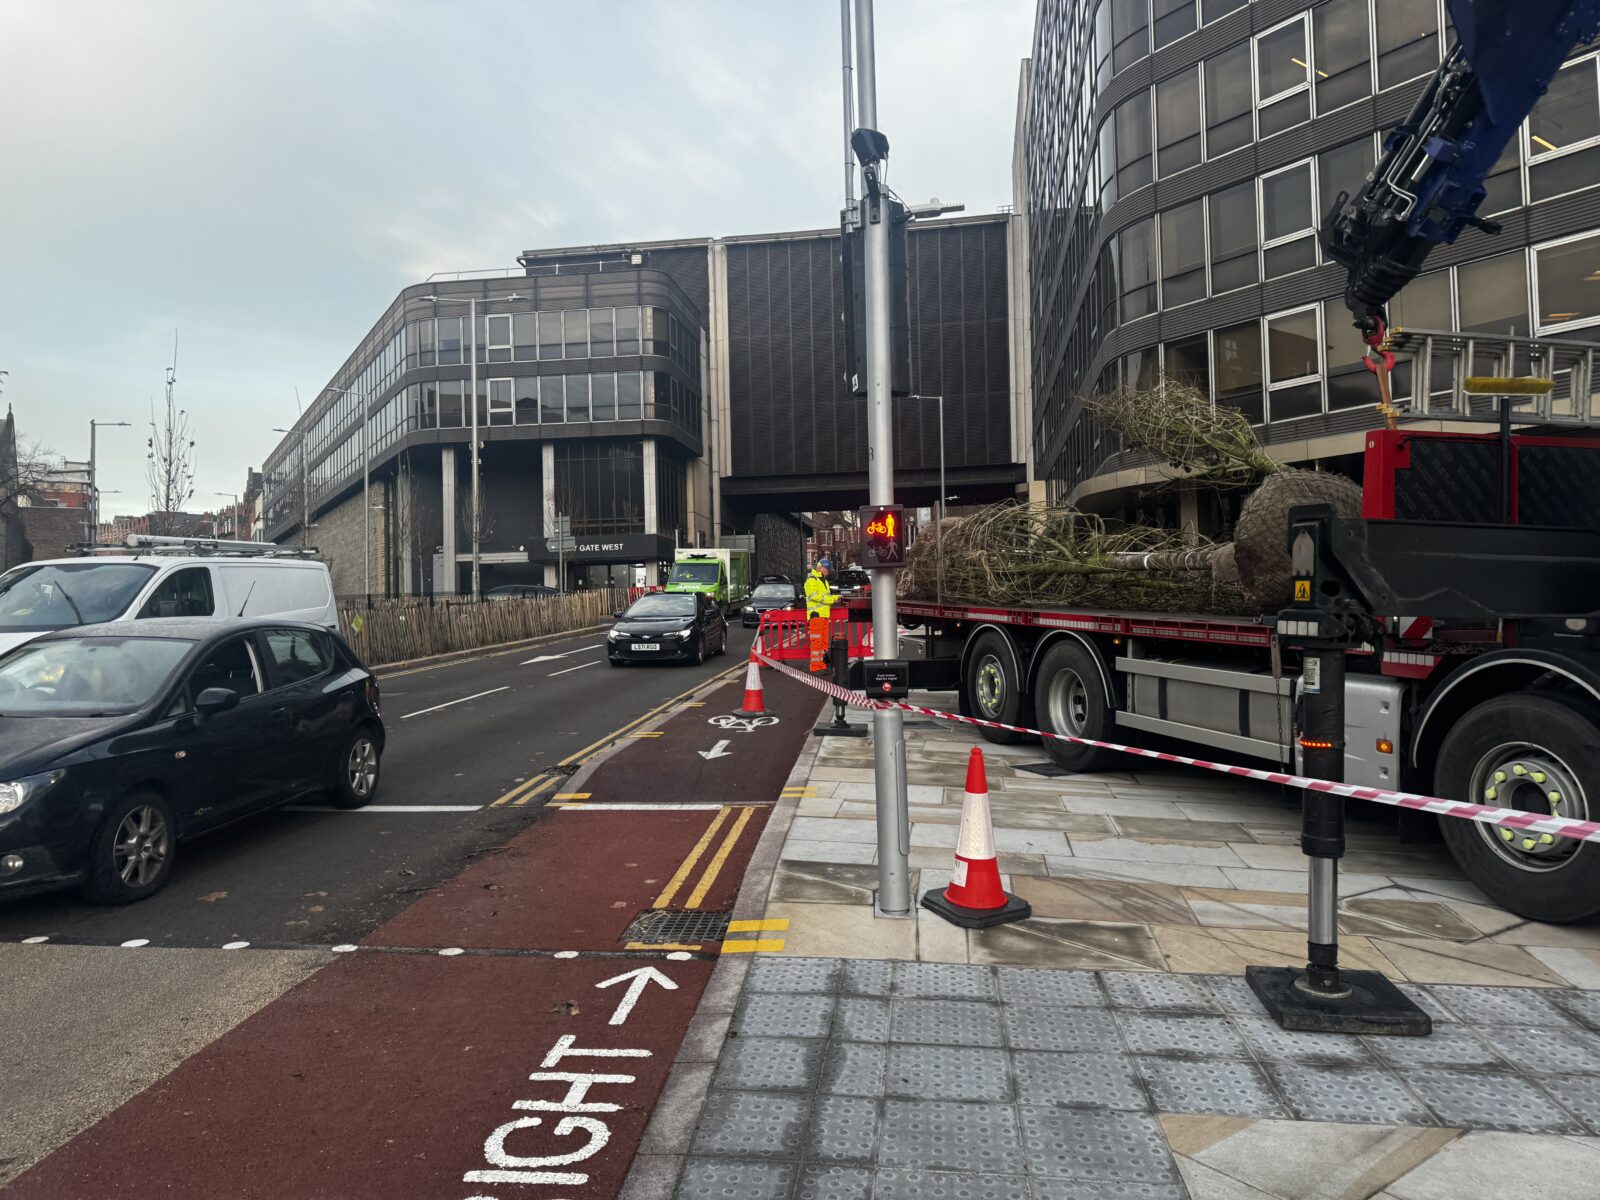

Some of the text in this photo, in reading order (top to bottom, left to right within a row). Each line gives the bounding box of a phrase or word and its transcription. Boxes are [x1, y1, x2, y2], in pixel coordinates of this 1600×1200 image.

[579, 544, 600, 552] GATE
[601, 543, 624, 551] WEST
[462, 1034, 653, 1200] IGHT
